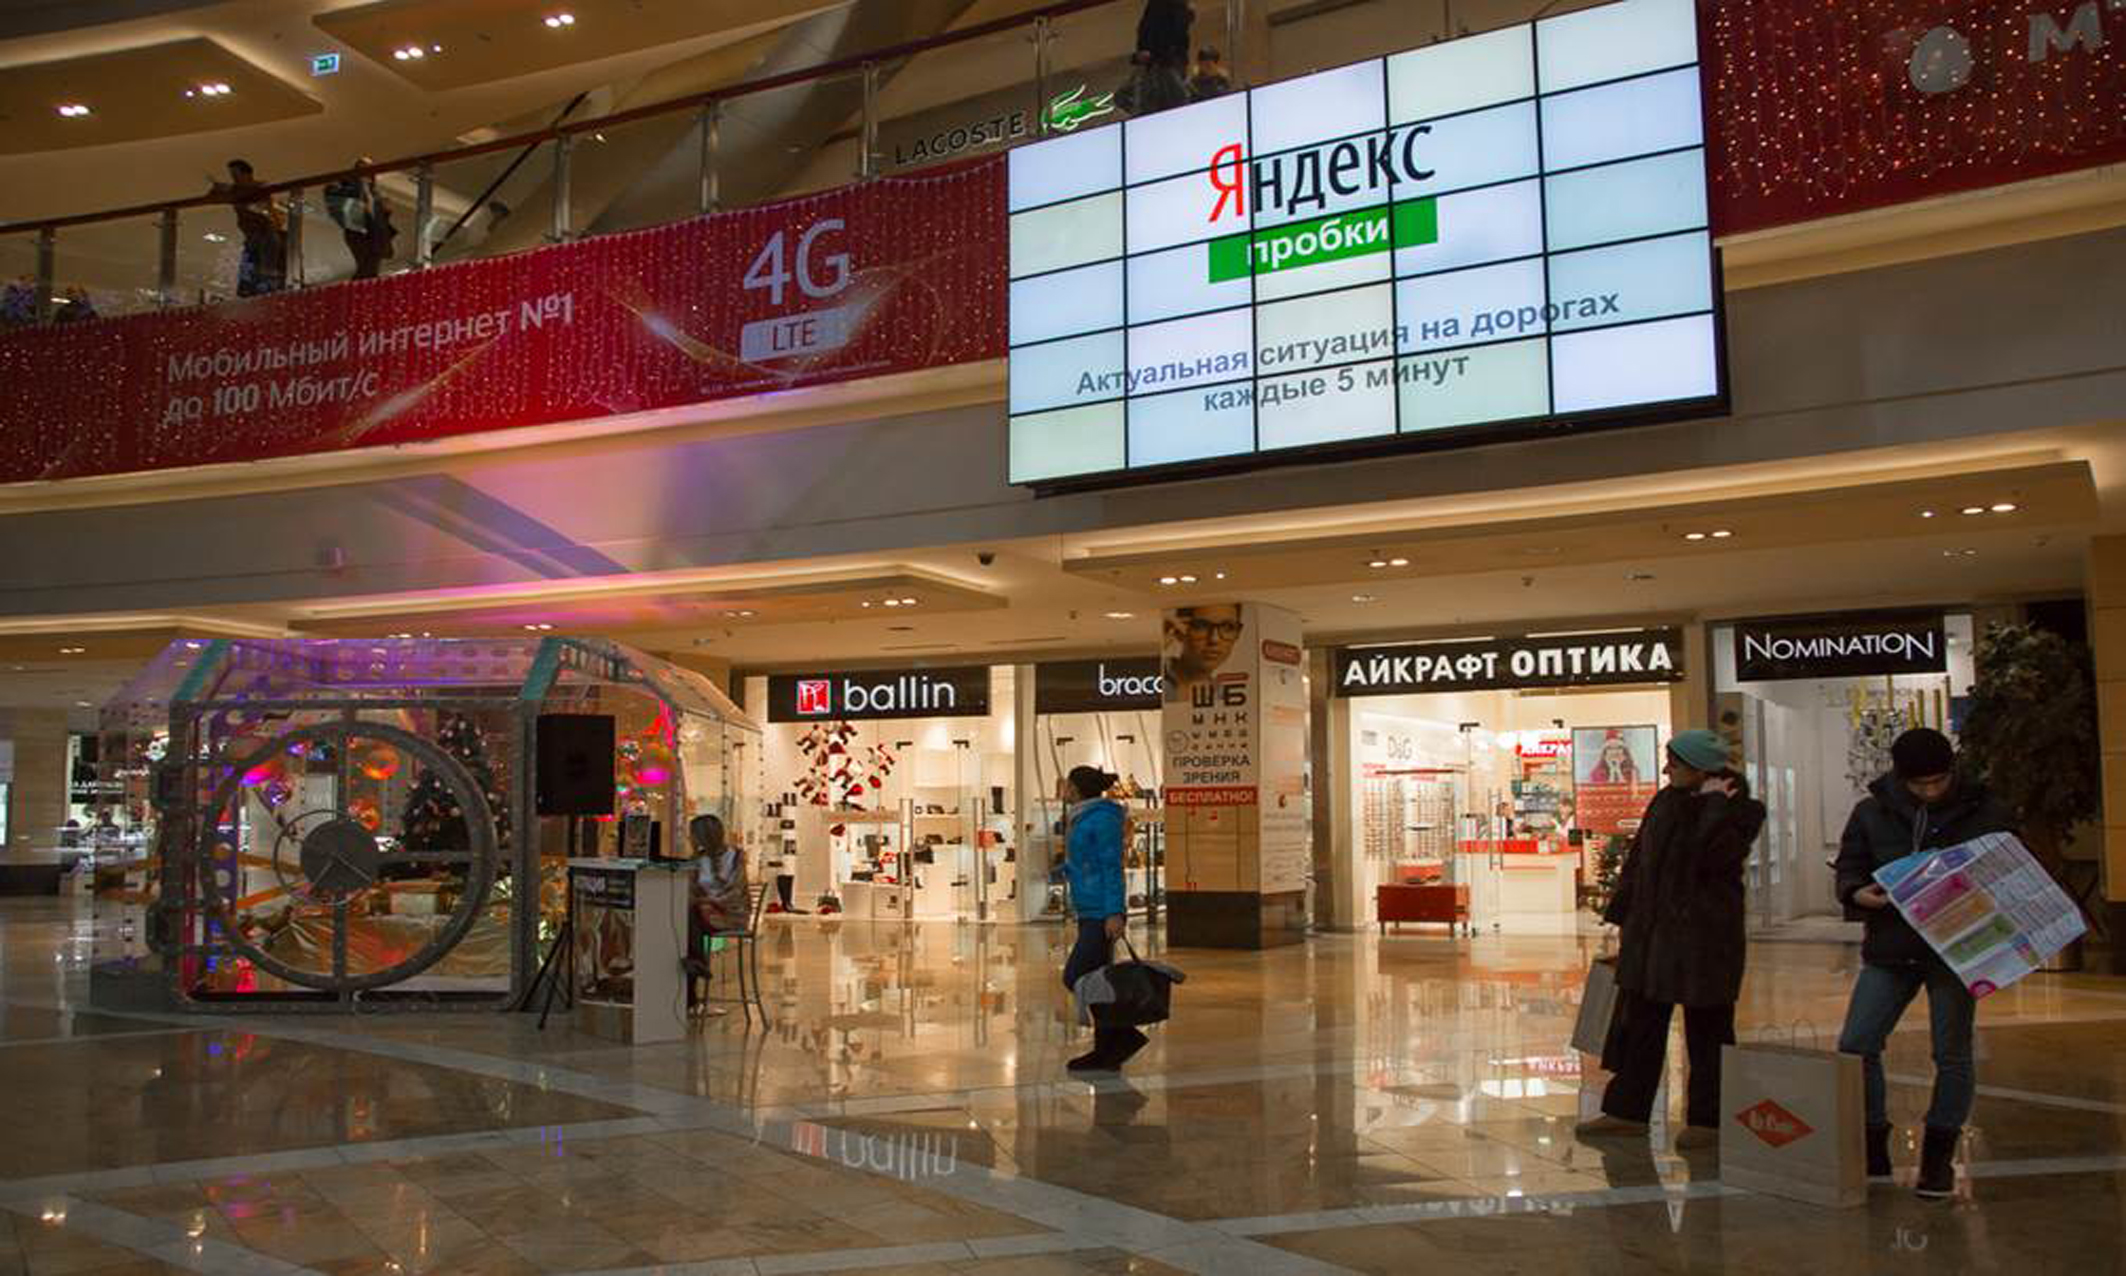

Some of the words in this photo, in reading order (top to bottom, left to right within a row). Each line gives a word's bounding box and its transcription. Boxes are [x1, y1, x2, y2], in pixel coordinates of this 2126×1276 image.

[895, 112, 1026, 164] LACOSTE
[1208, 125, 1436, 223] Яндекс
[743, 218, 850, 305] 4G
[1247, 217, 1387, 269] пробки
[167, 329, 349, 382] Мобильный
[359, 308, 511, 354] интернет
[519, 292, 575, 331] №1
[772, 318, 816, 351] LTE
[1076, 352, 1249, 395] Актуальная
[1259, 322, 1410, 366] ситуация
[1421, 312, 1460, 341] на
[1470, 292, 1621, 337] дорогах
[163, 396, 203, 427] до
[213, 383, 260, 416] 100
[269, 371, 380, 410] Мбит/с
[1203, 374, 1327, 412] каждые
[1336, 364, 1356, 393] 5
[1365, 353, 1470, 389] минут
[1344, 651, 1499, 687] АЙКРАФТ
[1511, 642, 1674, 677] ОПТИКА
[1743, 631, 1935, 663] NOMINATION
[843, 676, 956, 712] ballin
[1172, 753, 1251, 768] ПРОВЕРКА
[1182, 770, 1241, 785] ЗРЕНИЯ
